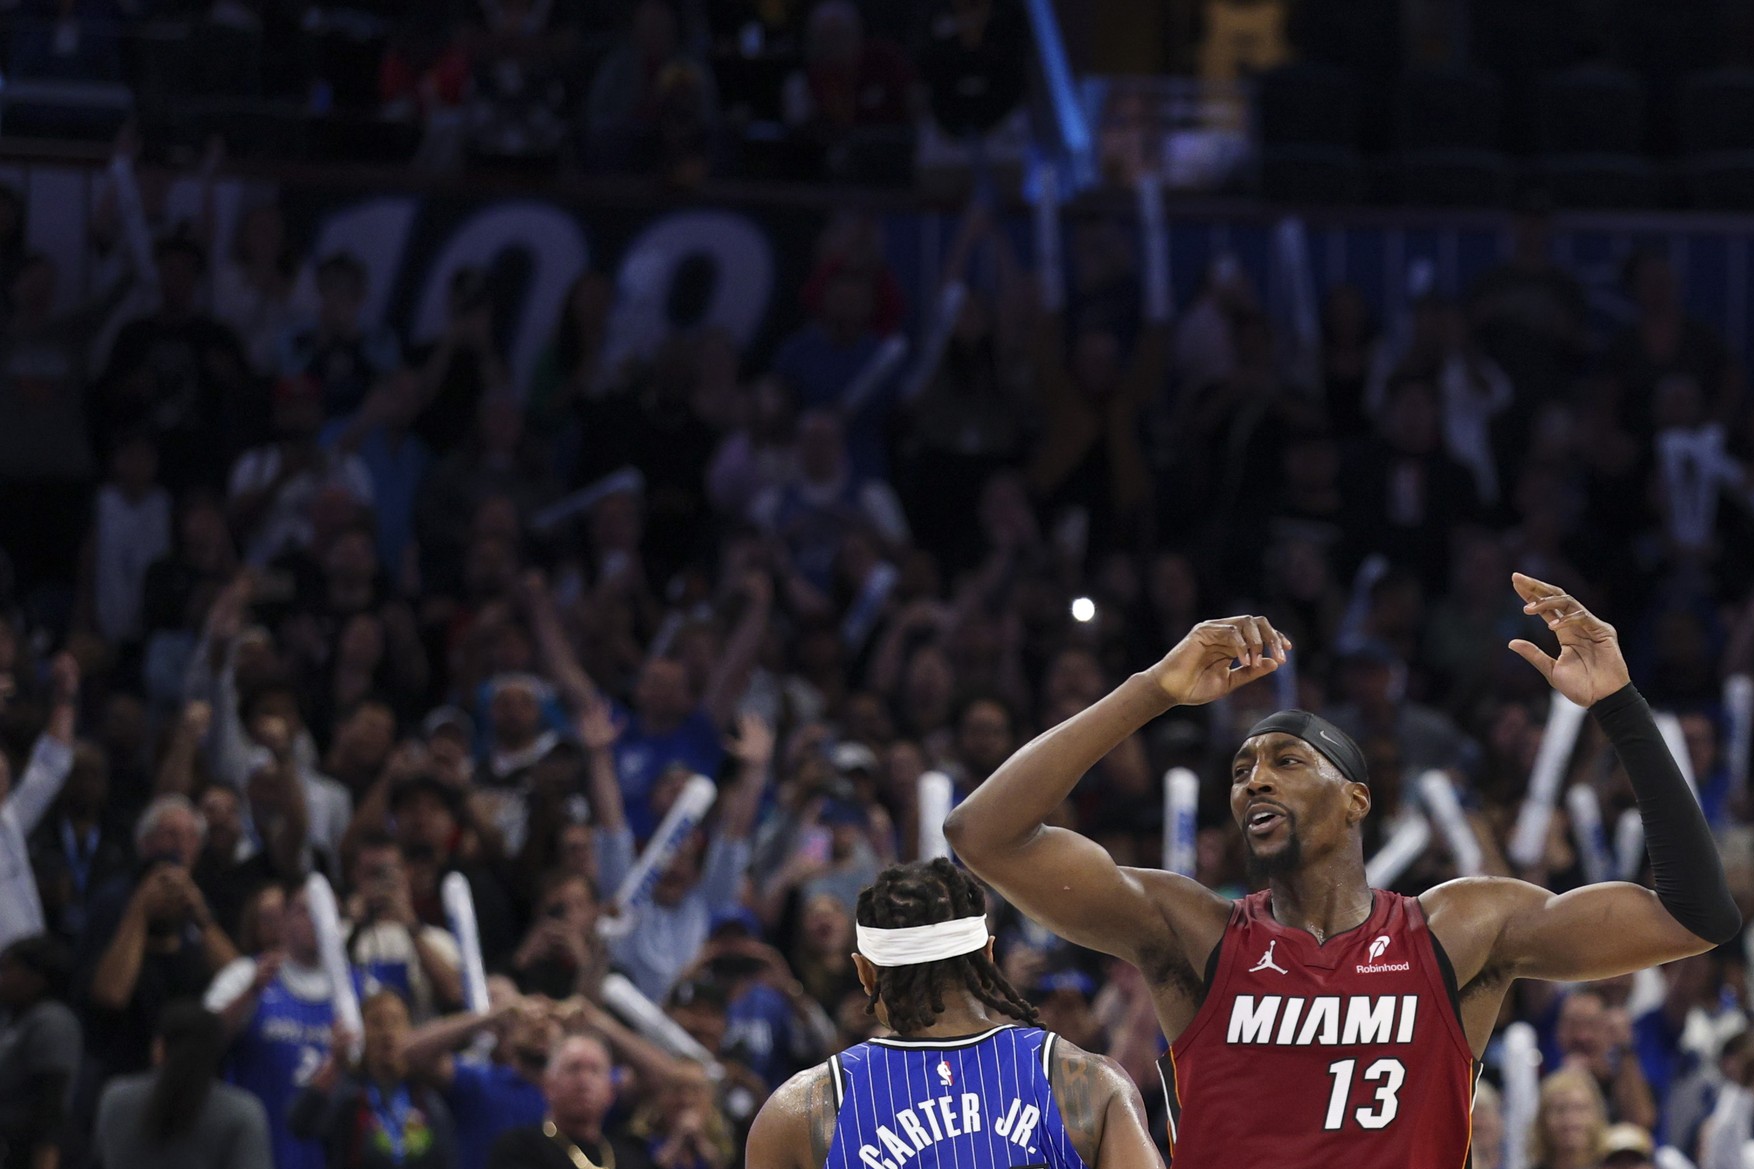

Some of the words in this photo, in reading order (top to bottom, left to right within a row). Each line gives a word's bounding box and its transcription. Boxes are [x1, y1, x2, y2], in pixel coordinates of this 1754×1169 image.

[1356, 962, 1410, 974] Robinhood
[1226, 994, 1418, 1045] MIAMI
[1323, 1057, 1406, 1130] 13
[994, 1097, 1041, 1154] JR.
